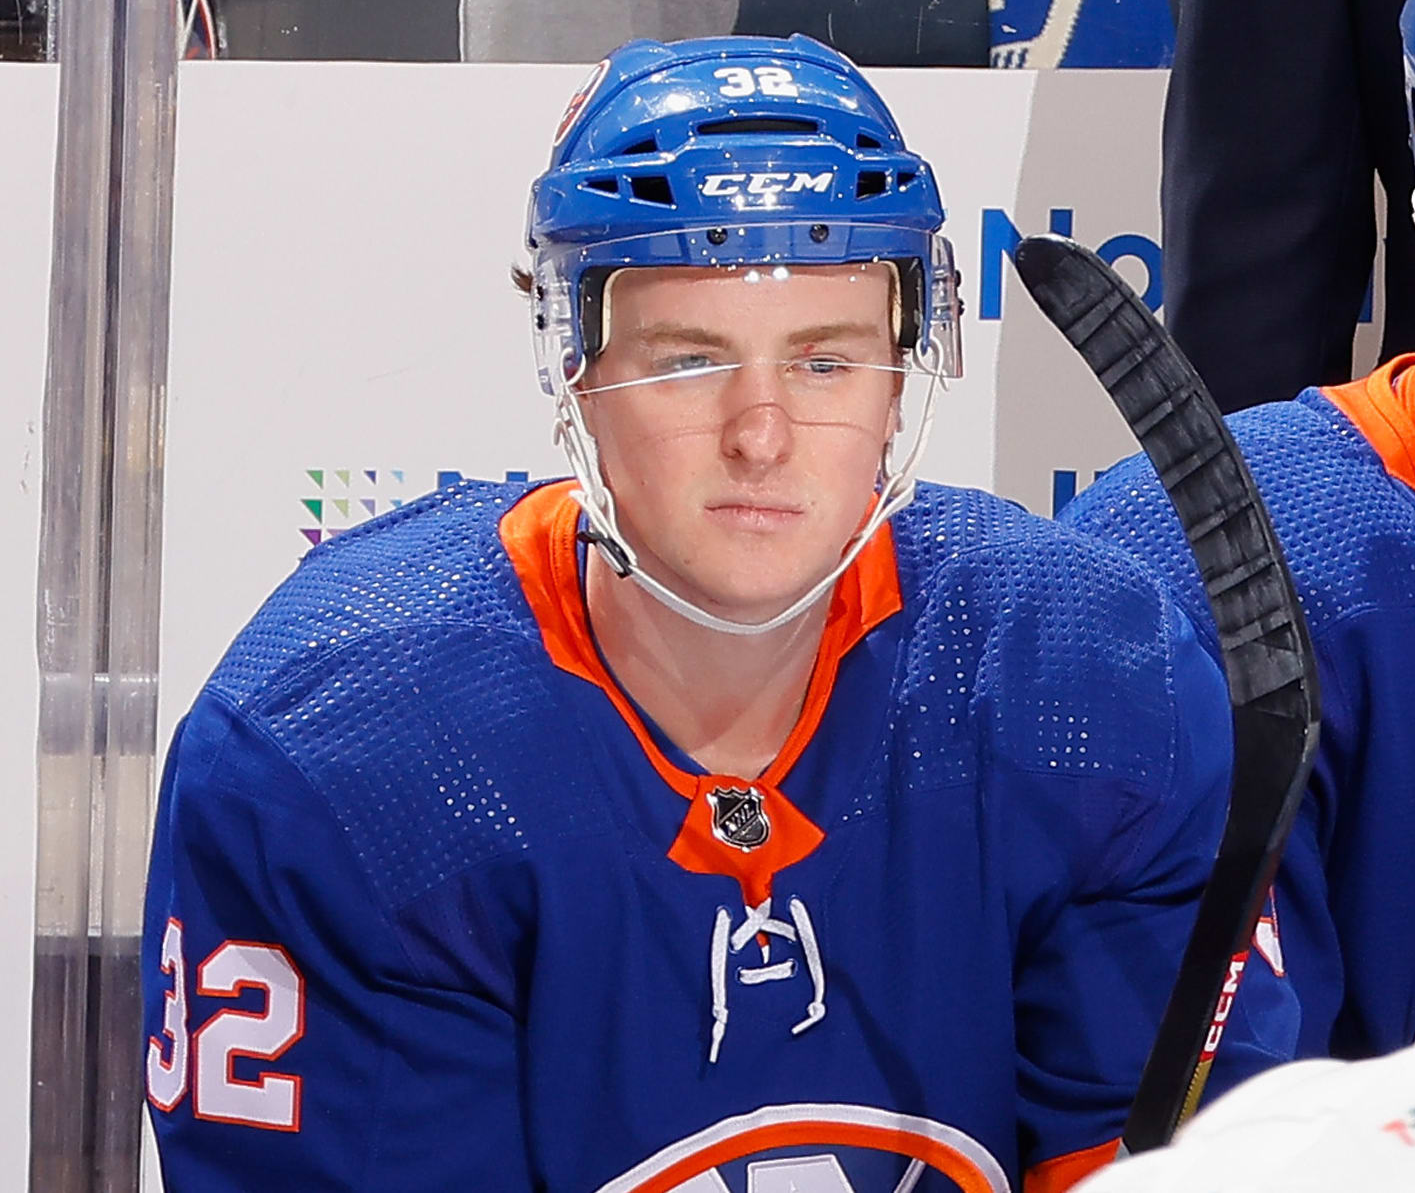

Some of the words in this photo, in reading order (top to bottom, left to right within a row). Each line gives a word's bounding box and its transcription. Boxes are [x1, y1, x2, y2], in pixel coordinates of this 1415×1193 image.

[713, 66, 799, 99] 32
[701, 171, 835, 197] CCM
[145, 916, 308, 1133] 32
[1203, 960, 1246, 1053] CCM
